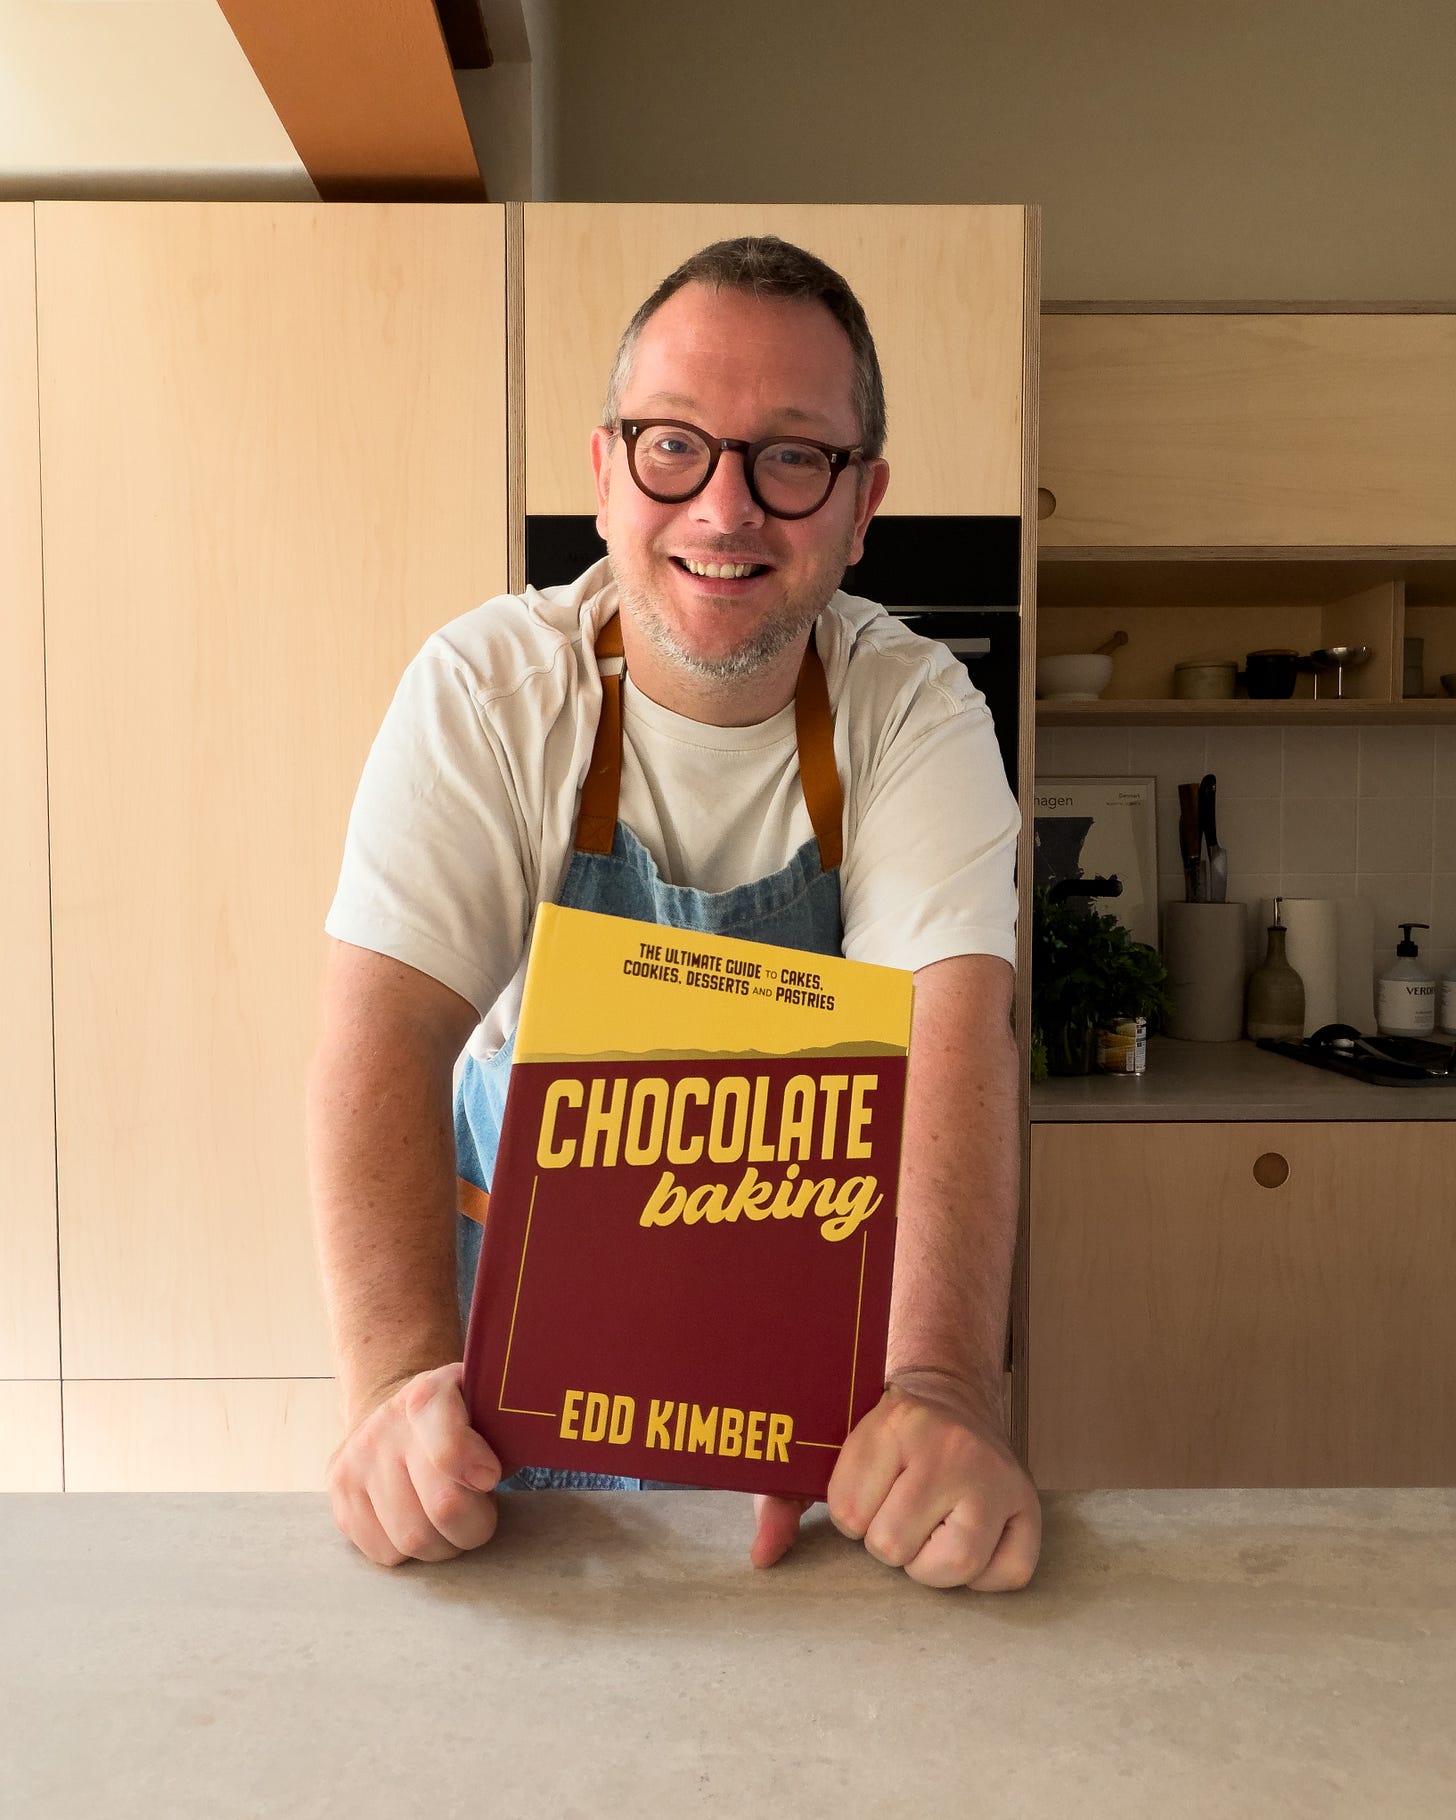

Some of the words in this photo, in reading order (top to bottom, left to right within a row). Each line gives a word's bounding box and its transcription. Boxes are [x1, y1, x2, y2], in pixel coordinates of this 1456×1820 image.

[639, 942, 662, 962] THE
[664, 947, 723, 972] ULTIMATE
[725, 959, 762, 980] GUIDE
[764, 969, 778, 980] TO
[686, 970, 750, 996] DESSERTS
[752, 986, 773, 998] AND
[775, 986, 836, 1011] PASTRIES
[536, 1074, 879, 1169] CHOCOLATE
[639, 1163, 884, 1242] baking
[559, 1389, 636, 1445] EDD
[645, 1399, 794, 1463] KIMBER
